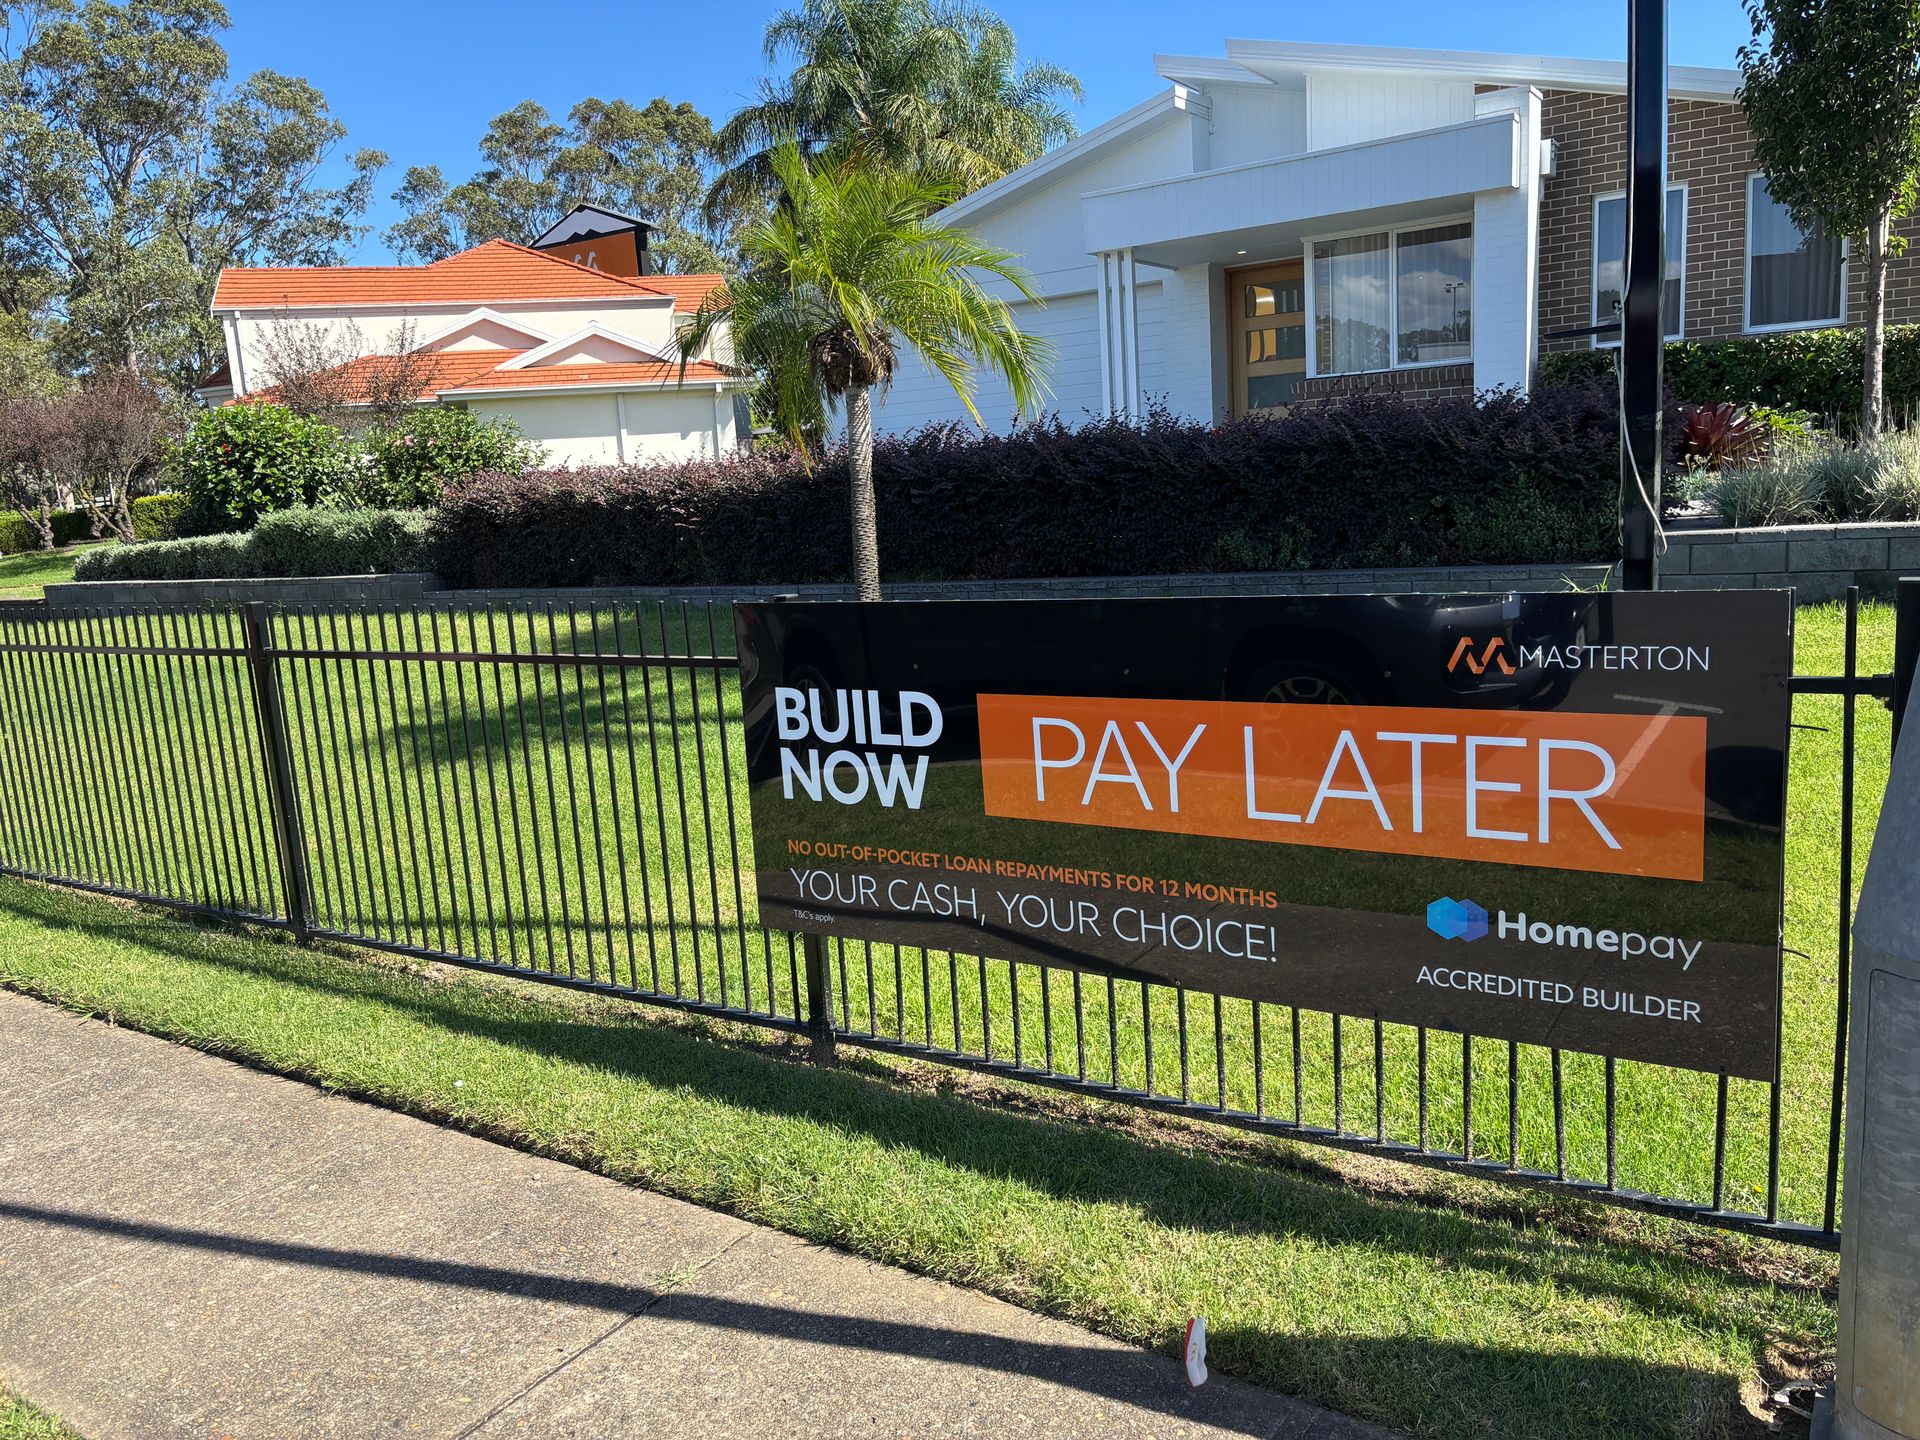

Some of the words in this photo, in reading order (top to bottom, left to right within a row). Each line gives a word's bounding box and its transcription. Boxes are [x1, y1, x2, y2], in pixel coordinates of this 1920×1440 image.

[1519, 645, 1710, 671] MASTERTON
[775, 687, 943, 748] BUILD
[779, 747, 930, 810] NOW
[1032, 716, 1207, 813] PAY
[1244, 725, 1623, 850] LATER
[787, 839, 811, 856] NO
[814, 842, 940, 869] OUT-OF-POCKET
[945, 854, 991, 874] LOAN
[996, 860, 1112, 889] REPAYMENTS
[1116, 874, 1155, 894] FOR
[1160, 880, 1180, 897] 12
[1185, 881, 1278, 909] MONTHS
[790, 867, 880, 907] YOUR
[888, 879, 986, 927] CASH,
[996, 890, 1102, 937] YOUR
[1112, 907, 1277, 963] CHOICE!
[793, 909, 814, 920] T&C's
[1498, 910, 1702, 971] Homepay
[1416, 965, 1574, 1005] ACCREDITED
[1583, 987, 1702, 1024] BUILDER
